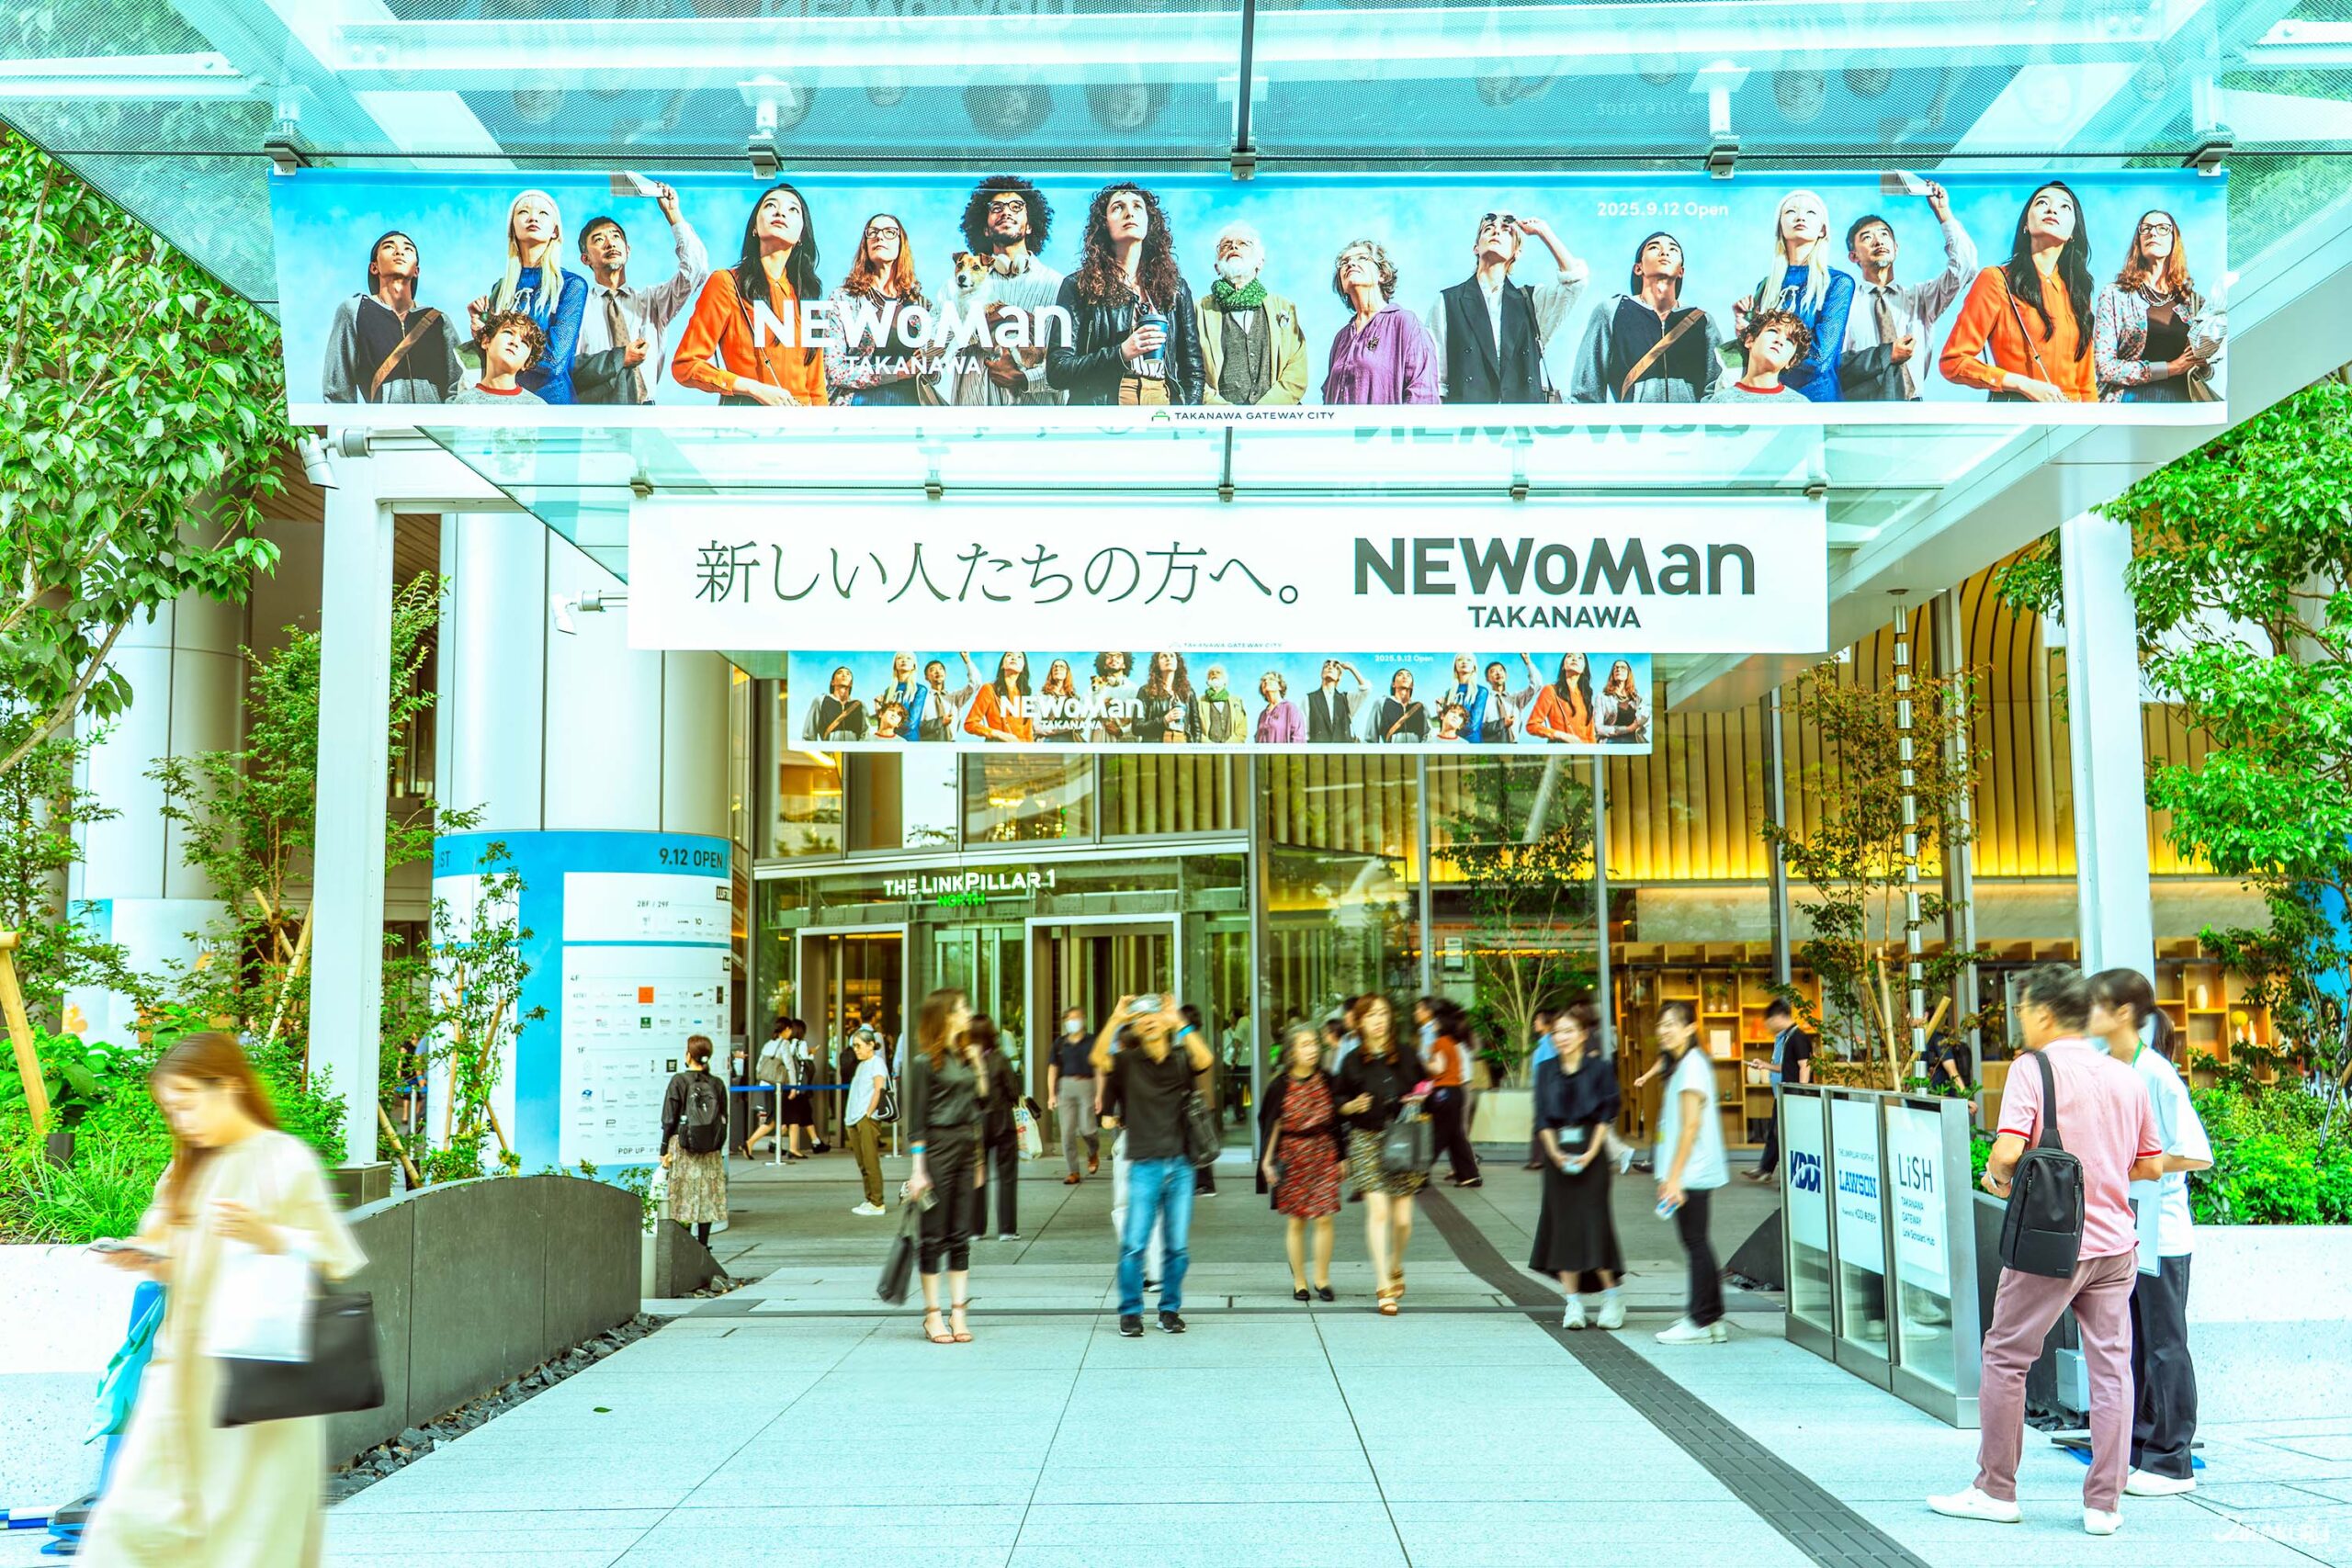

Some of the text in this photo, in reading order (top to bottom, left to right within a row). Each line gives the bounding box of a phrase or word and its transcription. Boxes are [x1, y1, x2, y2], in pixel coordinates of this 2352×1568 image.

[1597, 201, 1729, 220] 2025.9.12 Open
[752, 299, 1073, 348] NEWoMan
[844, 355, 981, 375] TAKANAWA
[1175, 412, 1335, 420] TAKANAWA GATEWAY CITY
[695, 539, 1298, 604] 新しい人たちの方へ。
[1353, 536, 1756, 595] NEWoMan
[1467, 605, 1642, 628] TAKANAWA
[1000, 694, 1145, 718] NEWoMan
[1041, 719, 1103, 730] TAKANAWA
[659, 847, 724, 869] 9.12 OPEN
[883, 879, 918, 897] THE
[1046, 869, 1056, 888] 1
[937, 893, 986, 908] NORTH
[1790, 1150, 1821, 1193] KDDI
[1898, 1153, 1934, 1193] LiSH
[1838, 1169, 1877, 1199] LAWSON
